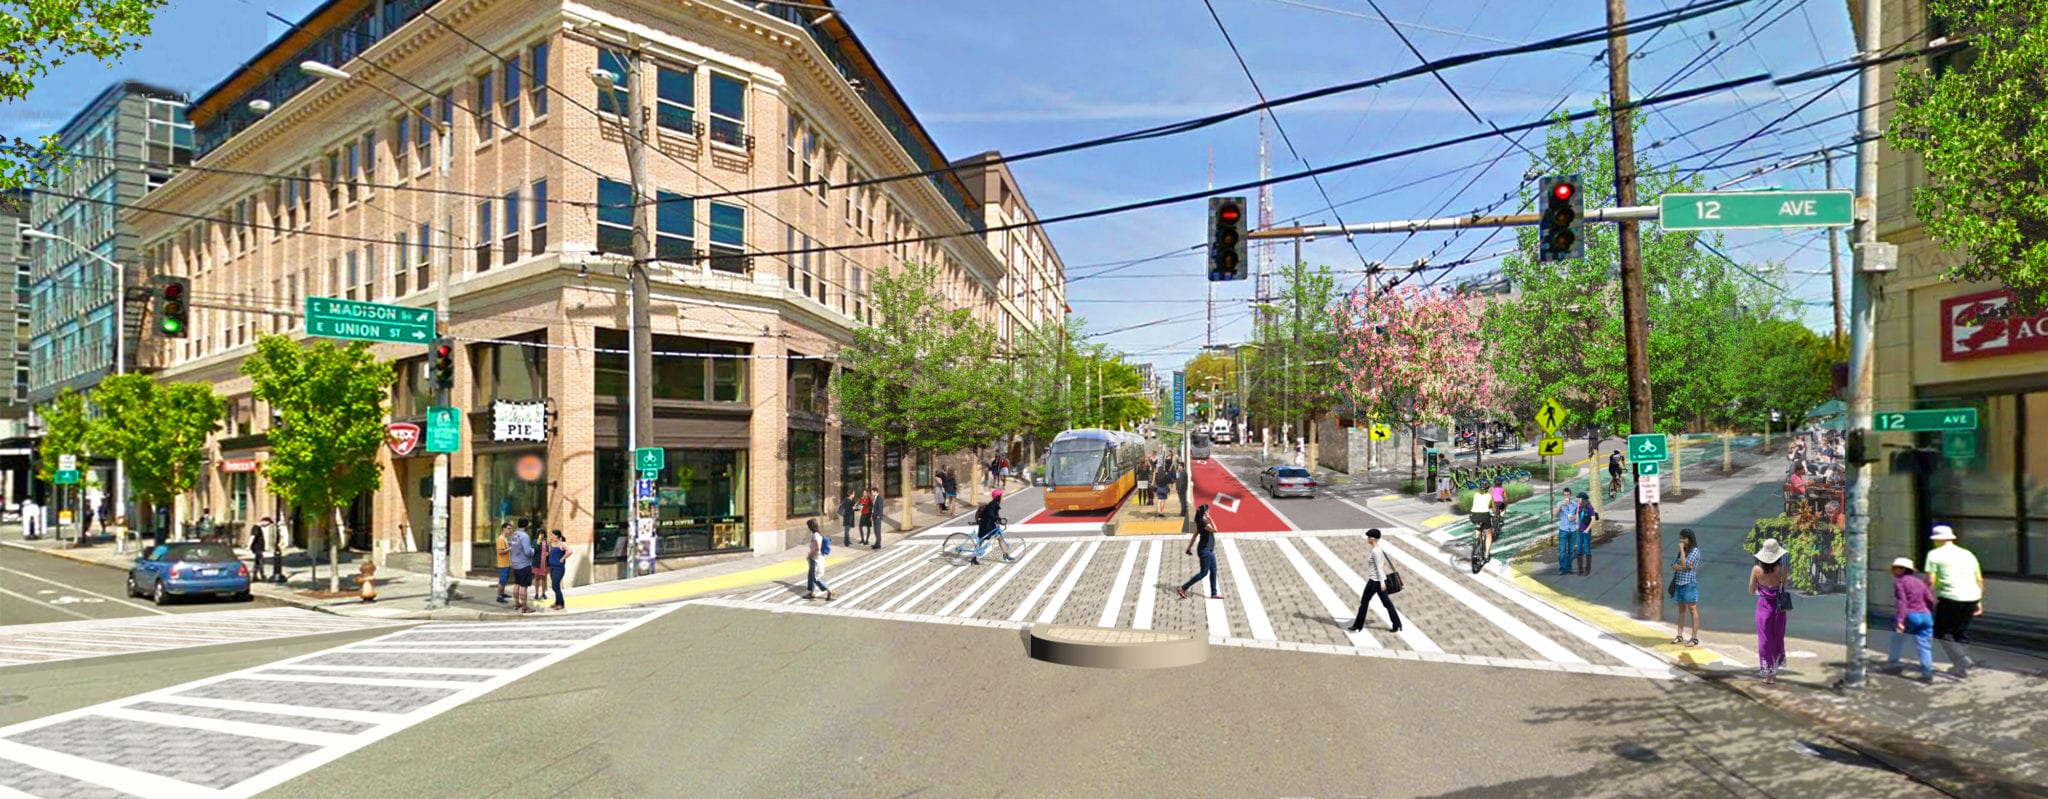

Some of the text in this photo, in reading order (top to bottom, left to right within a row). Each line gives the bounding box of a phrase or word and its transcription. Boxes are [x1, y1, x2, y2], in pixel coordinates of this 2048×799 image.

[1696, 200, 1817, 219] 12 AVE
[313, 302, 321, 312] E
[329, 302, 396, 320] MADISON
[316, 322, 401, 338] E UNION ST
[507, 424, 532, 435] PIE
[1881, 414, 1967, 429] 12 AVE
